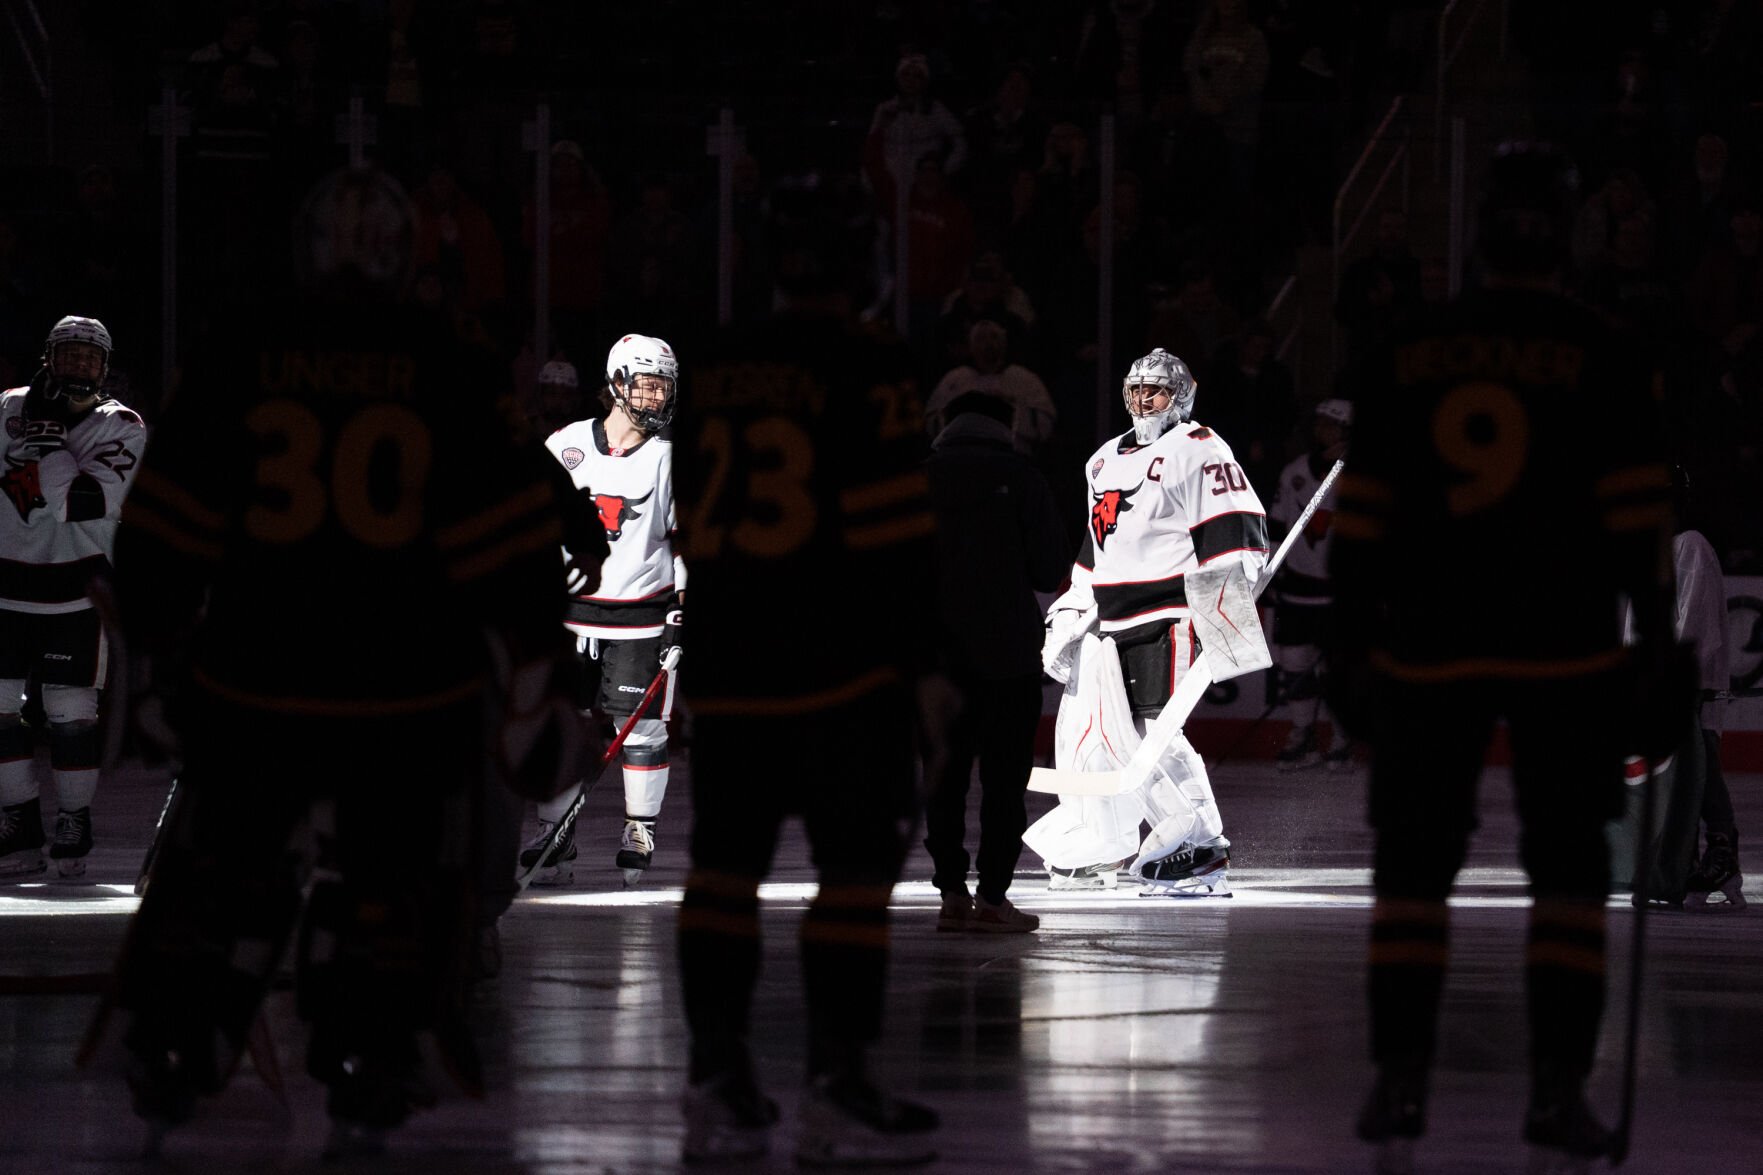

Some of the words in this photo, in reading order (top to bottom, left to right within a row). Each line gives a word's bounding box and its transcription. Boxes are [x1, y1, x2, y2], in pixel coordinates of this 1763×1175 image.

[258, 351, 416, 399] UNGER
[94, 440, 137, 482] 22
[1147, 456, 1164, 482] C
[1429, 381, 1532, 517] 9
[240, 400, 433, 549] 30
[677, 415, 817, 558] 23
[1204, 462, 1247, 496] 30
[618, 685, 646, 693] CCM
